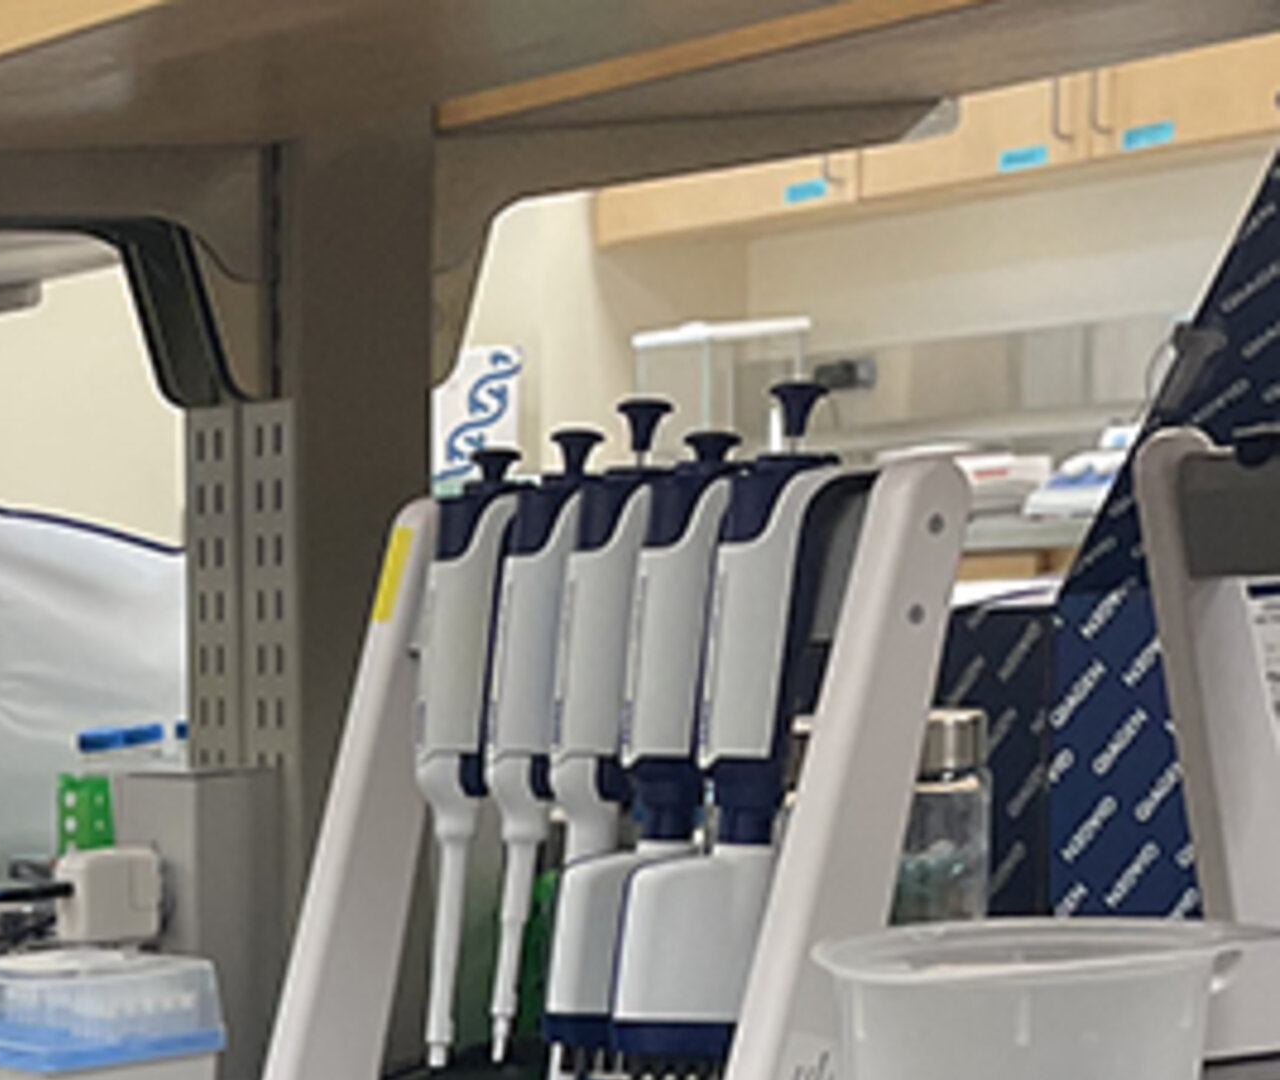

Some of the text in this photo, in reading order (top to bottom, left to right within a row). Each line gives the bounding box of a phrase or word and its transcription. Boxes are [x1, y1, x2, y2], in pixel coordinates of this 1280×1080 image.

[1049, 660, 1108, 728] QIAGEN
[1091, 706, 1149, 775] QIAGEN
[1059, 795, 1118, 863] QIAGEN
[1104, 841, 1162, 909] QIAGEN
